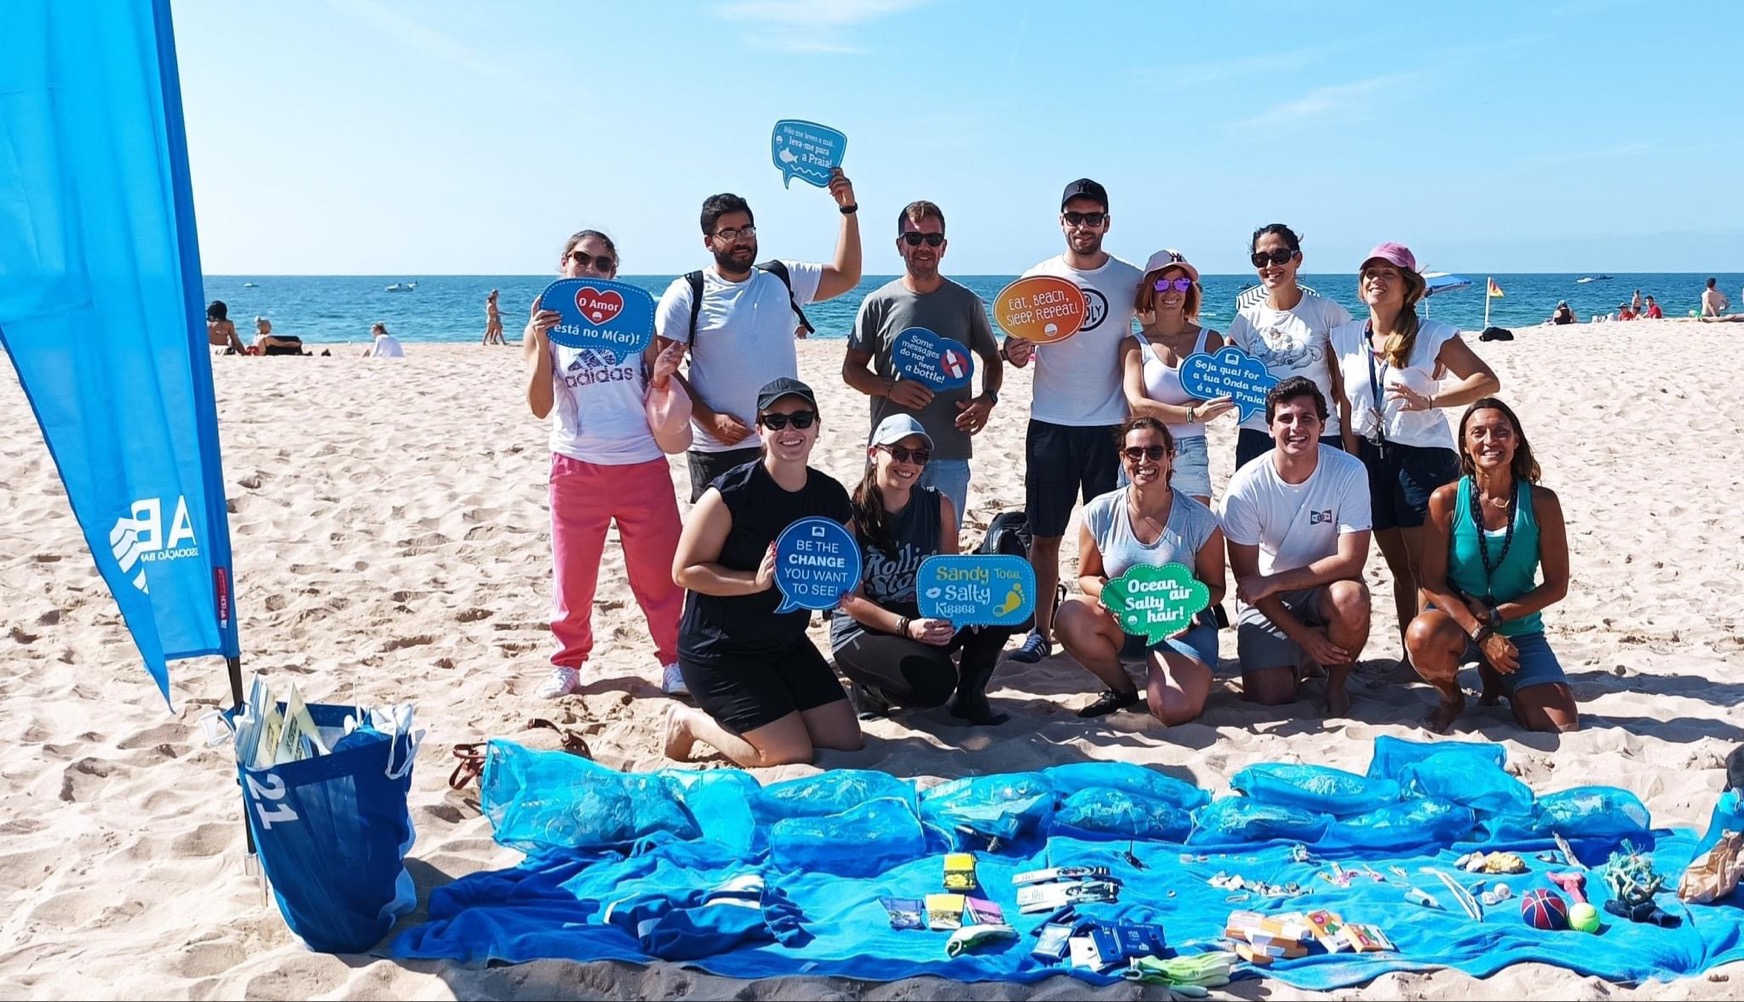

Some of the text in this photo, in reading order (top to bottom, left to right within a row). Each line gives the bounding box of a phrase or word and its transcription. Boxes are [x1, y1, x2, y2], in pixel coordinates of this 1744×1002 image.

[789, 136, 830, 156] leva-me para
[808, 154, 832, 168] Praia!
[579, 298, 619, 312] O Amor
[1033, 289, 1069, 306] Beach,
[554, 324, 640, 346] está no M(ar)!
[910, 335, 934, 349] Some
[900, 348, 925, 361] do not
[902, 340, 940, 359] messages
[918, 361, 935, 371] need
[1195, 360, 1259, 380] Seja qual for
[565, 365, 633, 388] adidas
[913, 365, 945, 384] bottle!
[1203, 374, 1220, 383] tua
[1223, 377, 1249, 390] Onda
[1196, 382, 1203, 391] é
[1215, 388, 1232, 397] tua
[796, 540, 839, 554] BE THE
[788, 554, 845, 568] CHANGE
[863, 543, 937, 580] Rolli
[784, 567, 848, 583] YOU WANT
[936, 566, 989, 585] Sandy
[792, 583, 838, 597] TO SEE!
[1127, 579, 1178, 593] Ocean
[1169, 586, 1193, 600] air
[945, 584, 991, 605] Salty
[936, 602, 976, 618] Kisses
[1125, 596, 1165, 611] Salty
[1147, 606, 1184, 623] hair!
[246, 773, 299, 830] 21
